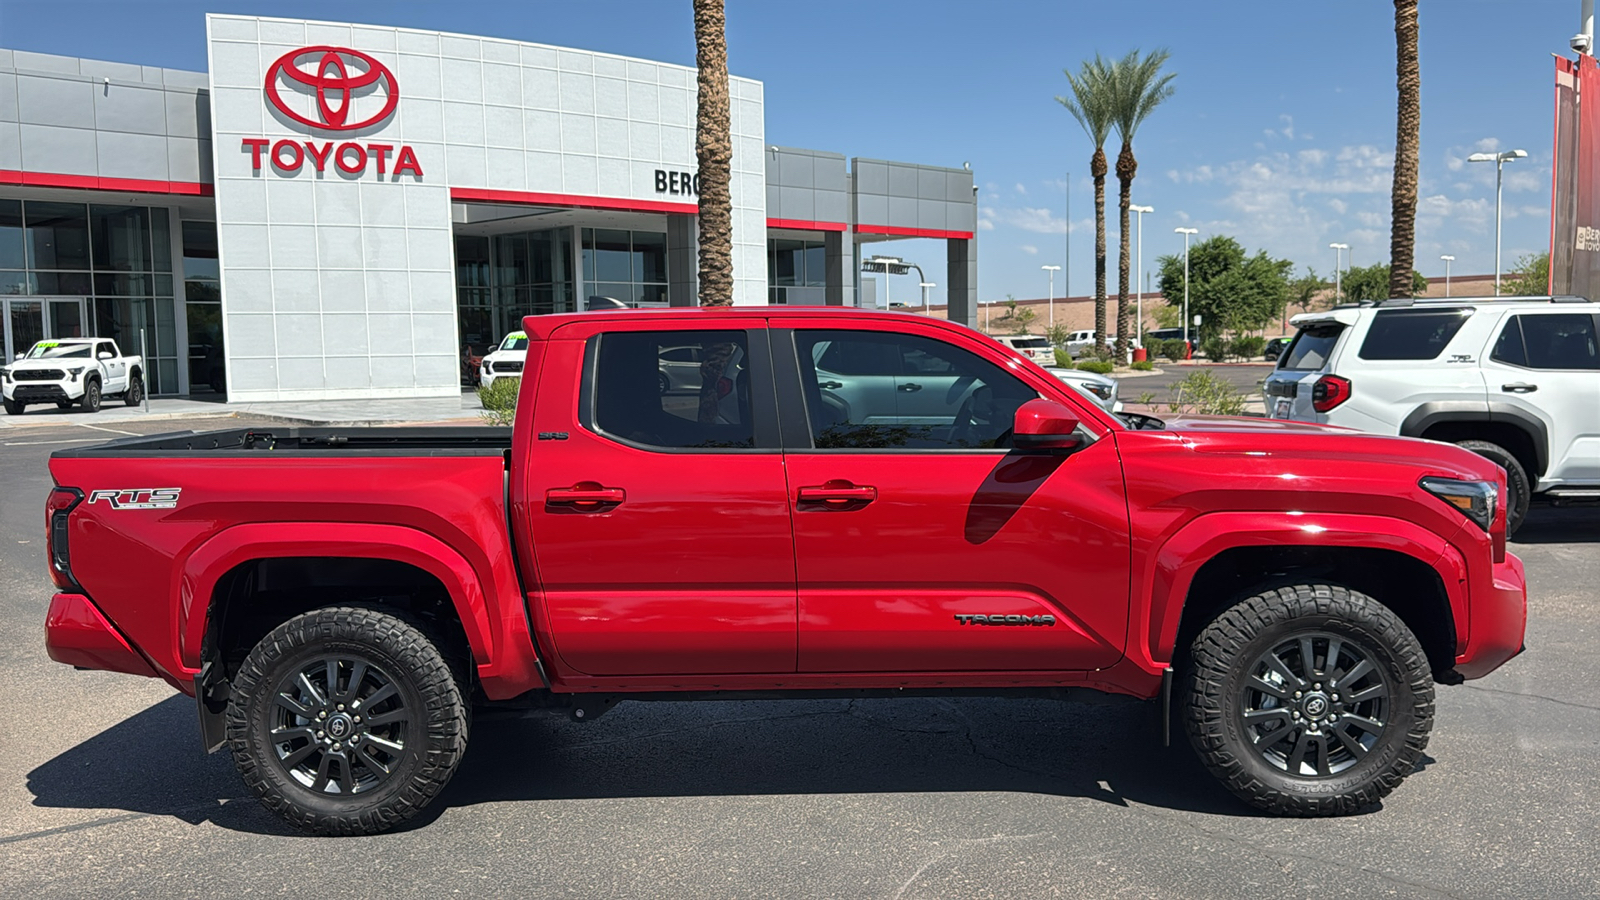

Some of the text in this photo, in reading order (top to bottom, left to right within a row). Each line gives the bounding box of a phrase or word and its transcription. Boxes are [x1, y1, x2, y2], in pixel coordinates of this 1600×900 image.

[242, 138, 424, 177] TOYOTA
[87, 487, 181, 509] RTS
[954, 614, 1056, 626] TACOMA
